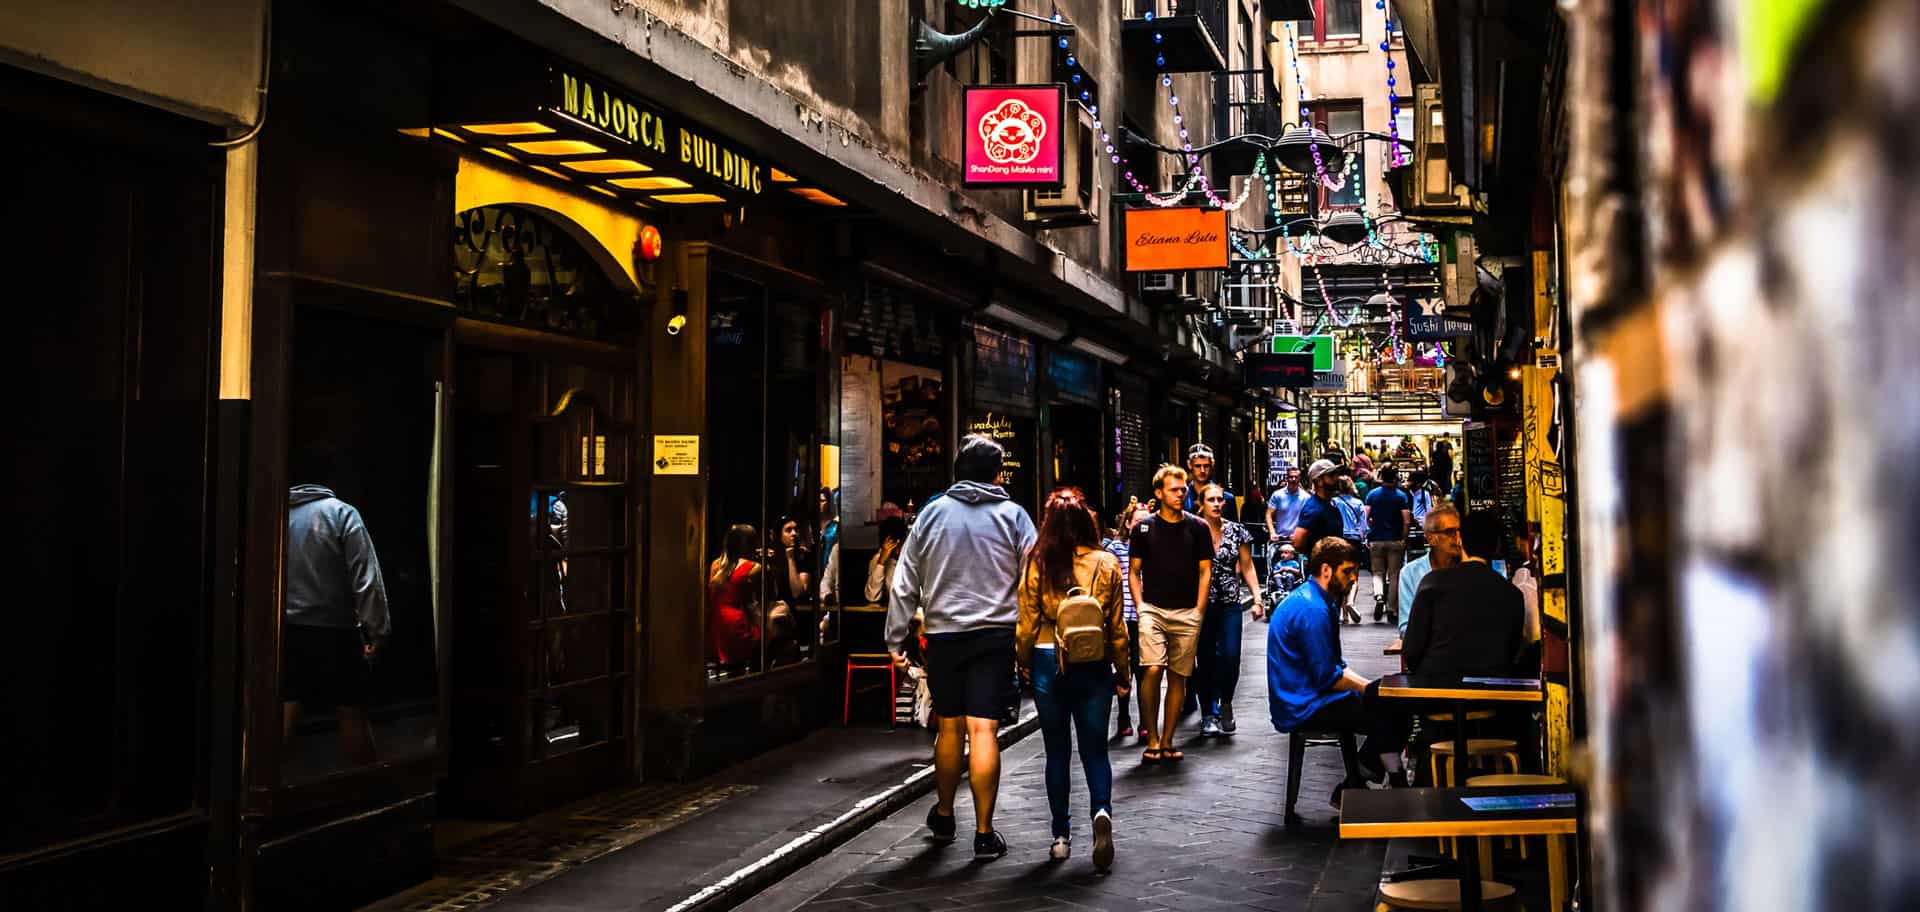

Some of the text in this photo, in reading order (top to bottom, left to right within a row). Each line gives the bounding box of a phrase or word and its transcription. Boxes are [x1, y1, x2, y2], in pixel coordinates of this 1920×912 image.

[563, 72, 762, 194] MAJORCA BUILDING
[1184, 230, 1217, 245] Lulu
[1409, 317, 1439, 335] Sushi
[1270, 438, 1290, 450] SKA
